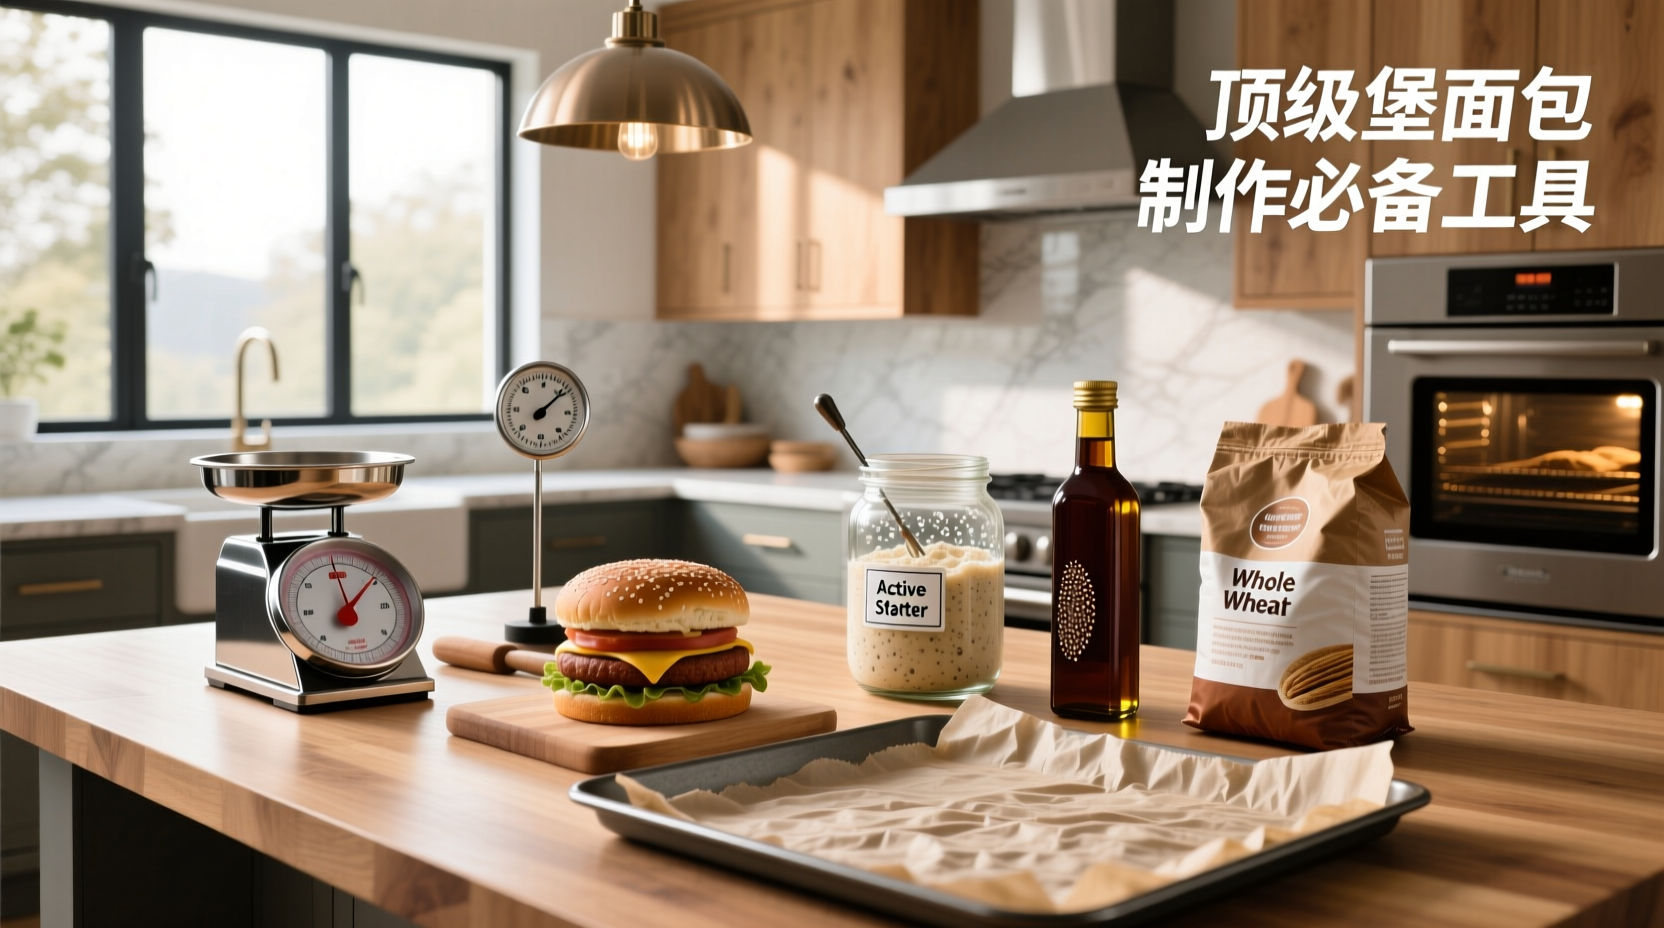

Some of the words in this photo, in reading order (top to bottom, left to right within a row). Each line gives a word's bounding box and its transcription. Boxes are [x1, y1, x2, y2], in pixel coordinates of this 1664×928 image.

[877, 579, 927, 597] Active
[1232, 567, 1295, 592] Whole
[1224, 590, 1292, 617] Wheat
